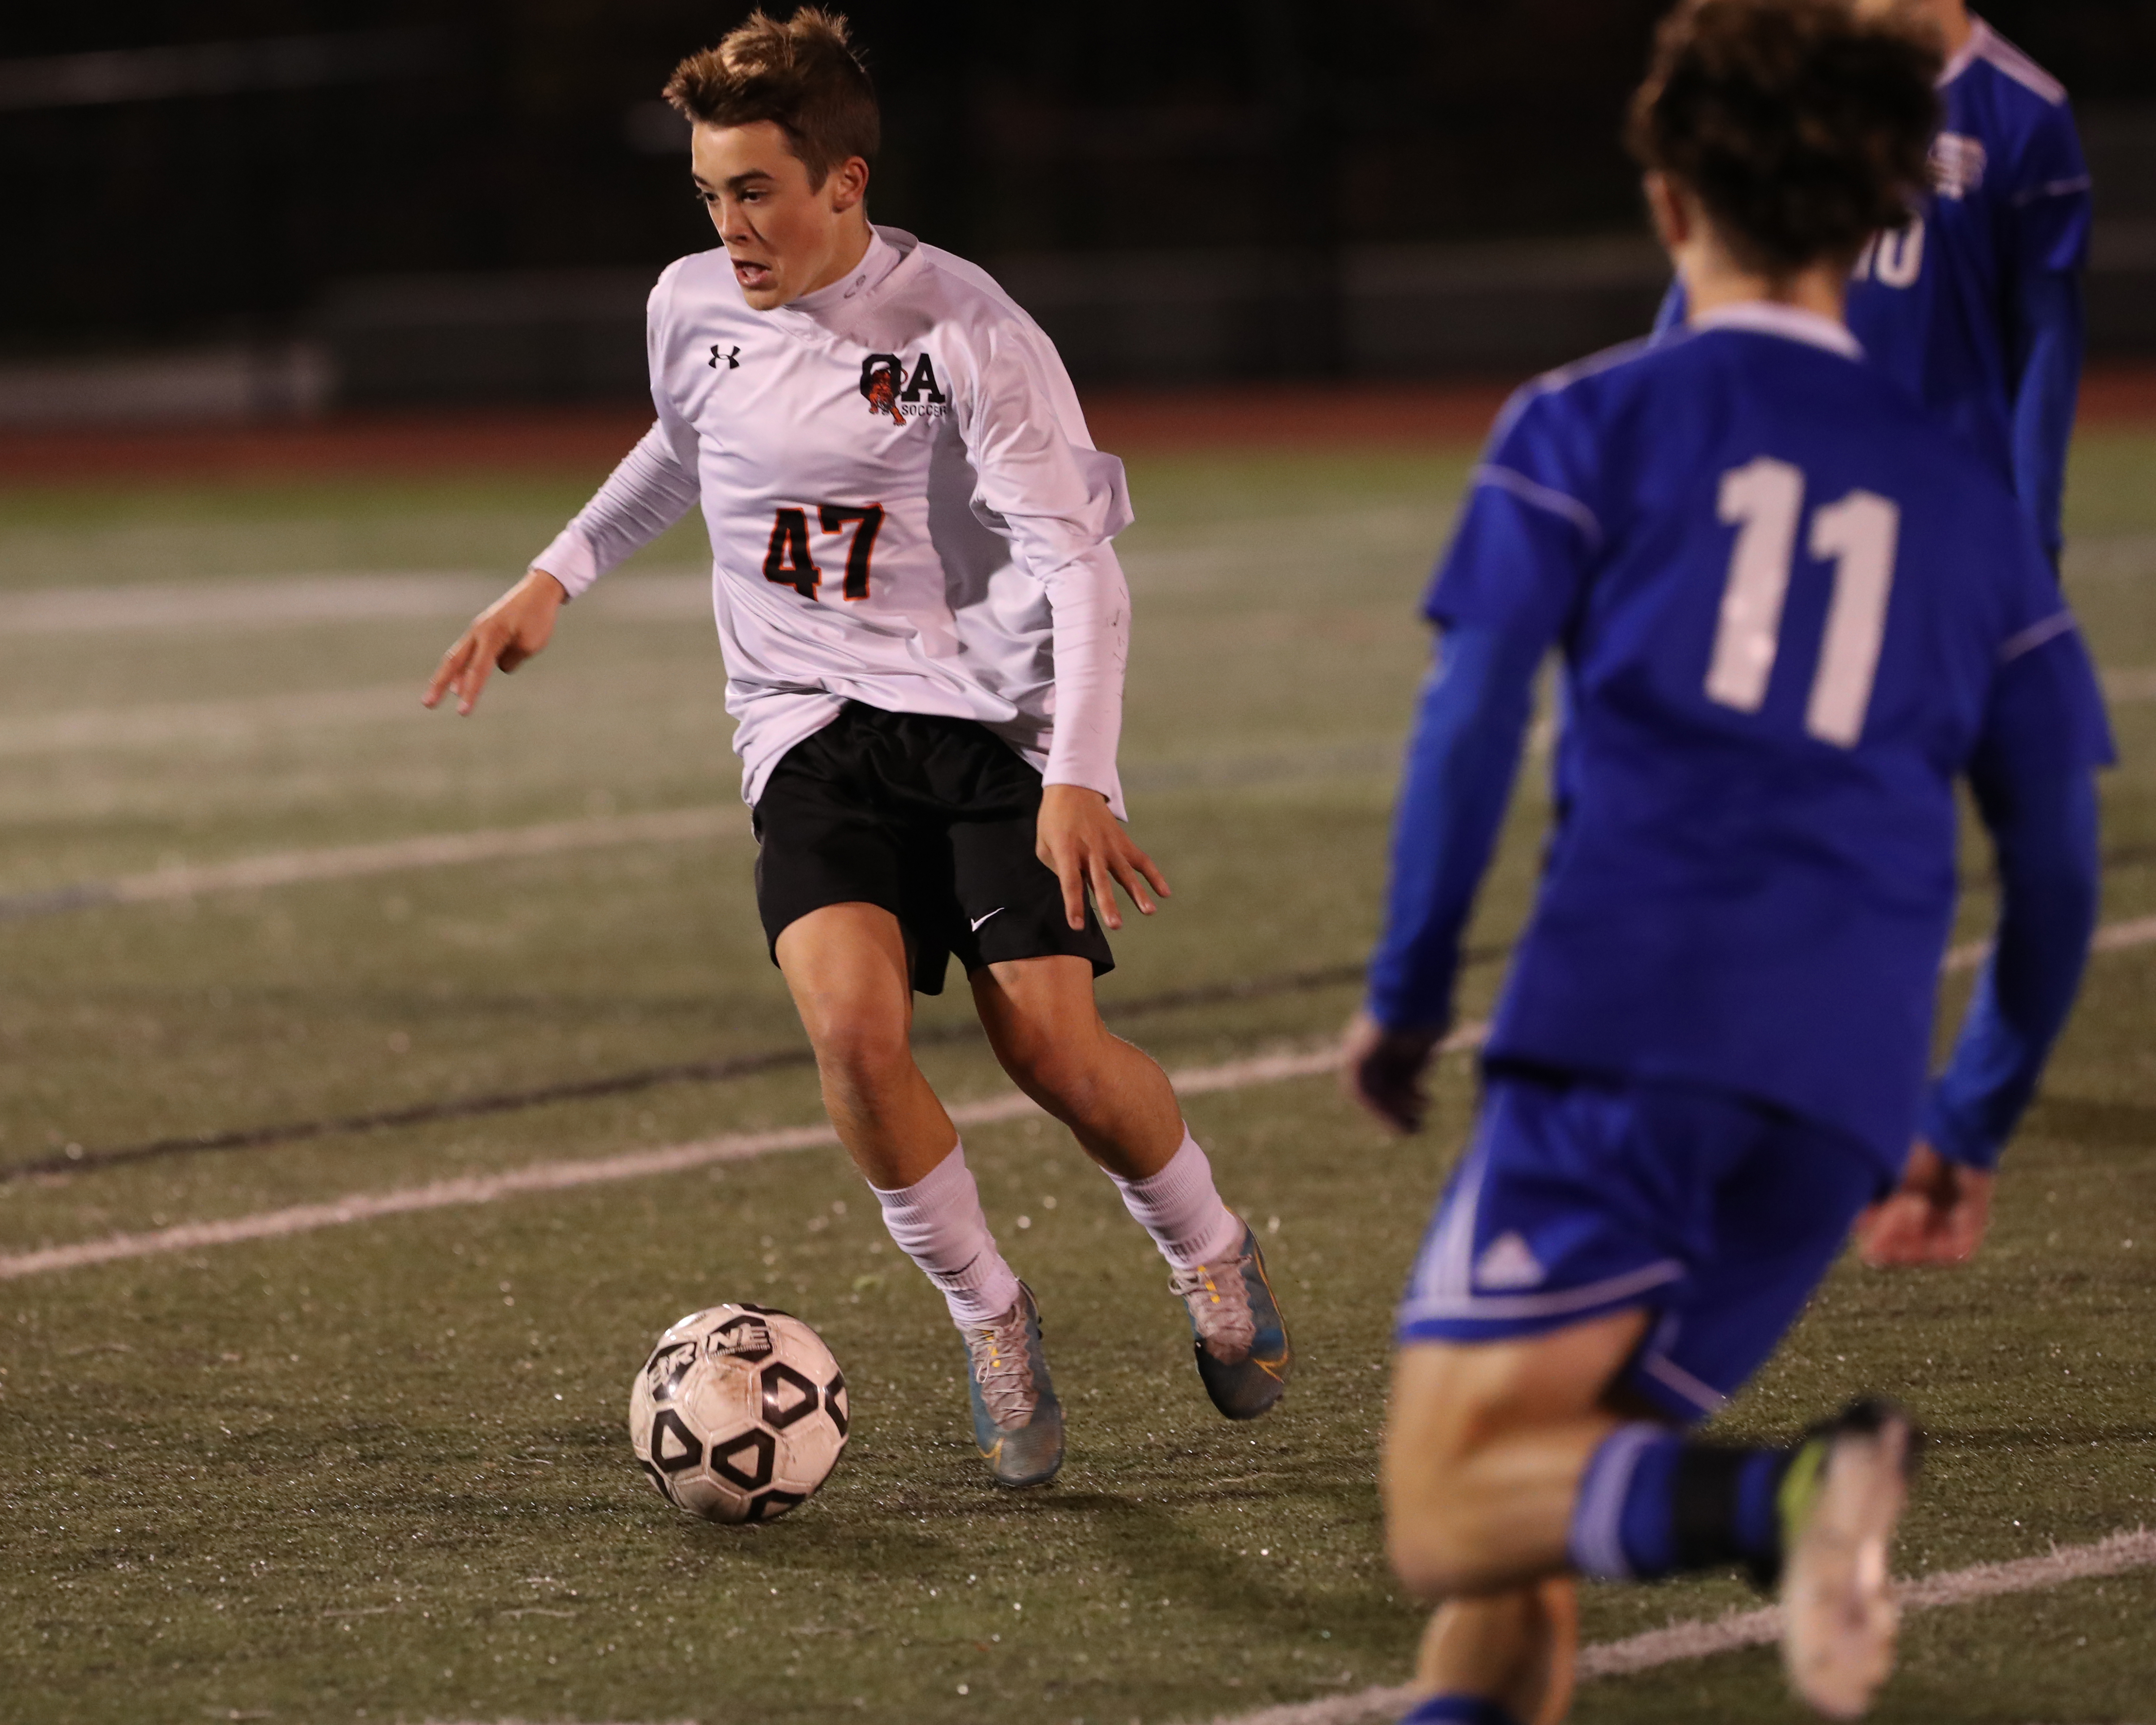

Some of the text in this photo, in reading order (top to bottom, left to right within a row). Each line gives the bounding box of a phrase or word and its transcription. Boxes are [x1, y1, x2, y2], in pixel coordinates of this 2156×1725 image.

[901, 404, 946, 417] SOCCER
[763, 502, 885, 602] 47
[1704, 454, 1900, 748] 11
